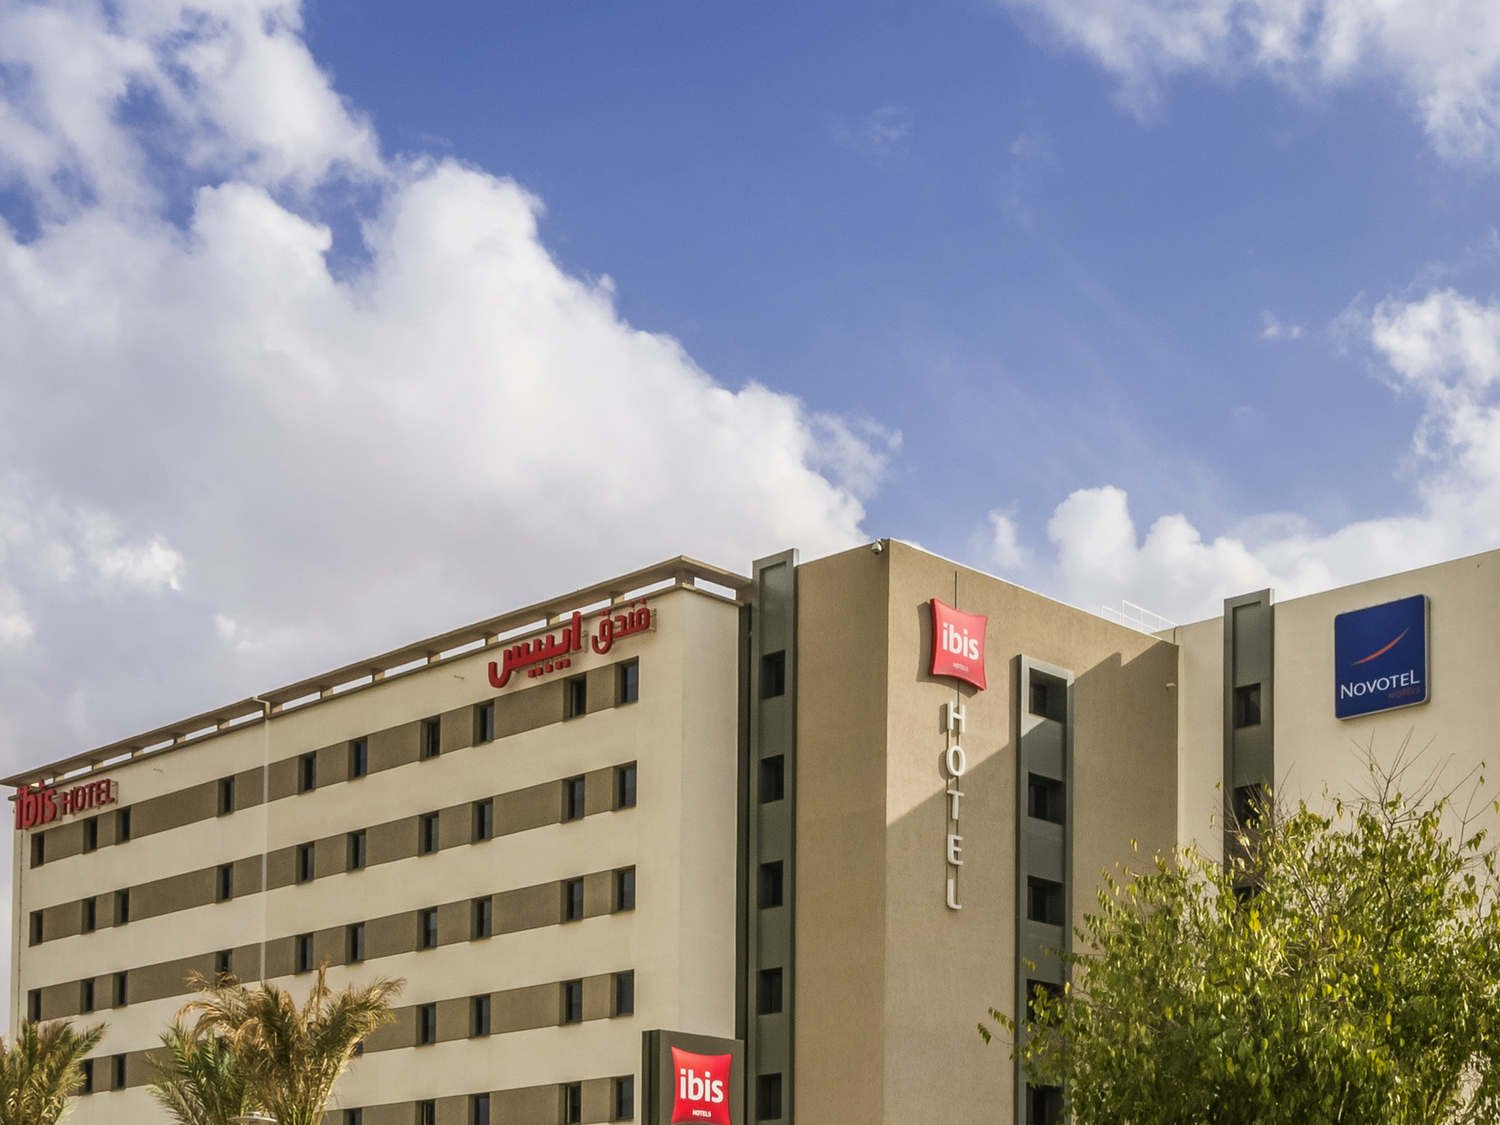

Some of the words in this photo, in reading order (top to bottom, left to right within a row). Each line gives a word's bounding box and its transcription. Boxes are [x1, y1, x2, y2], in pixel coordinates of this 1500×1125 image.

[592, 597, 650, 655] فندق
[942, 621, 979, 661] ibis
[1340, 669, 1421, 700] NOVOTEL
[16, 778, 57, 830] ibis
[61, 778, 115, 816] HOTEL
[945, 700, 966, 910] HOTEL
[680, 1068, 724, 1104] ibis
